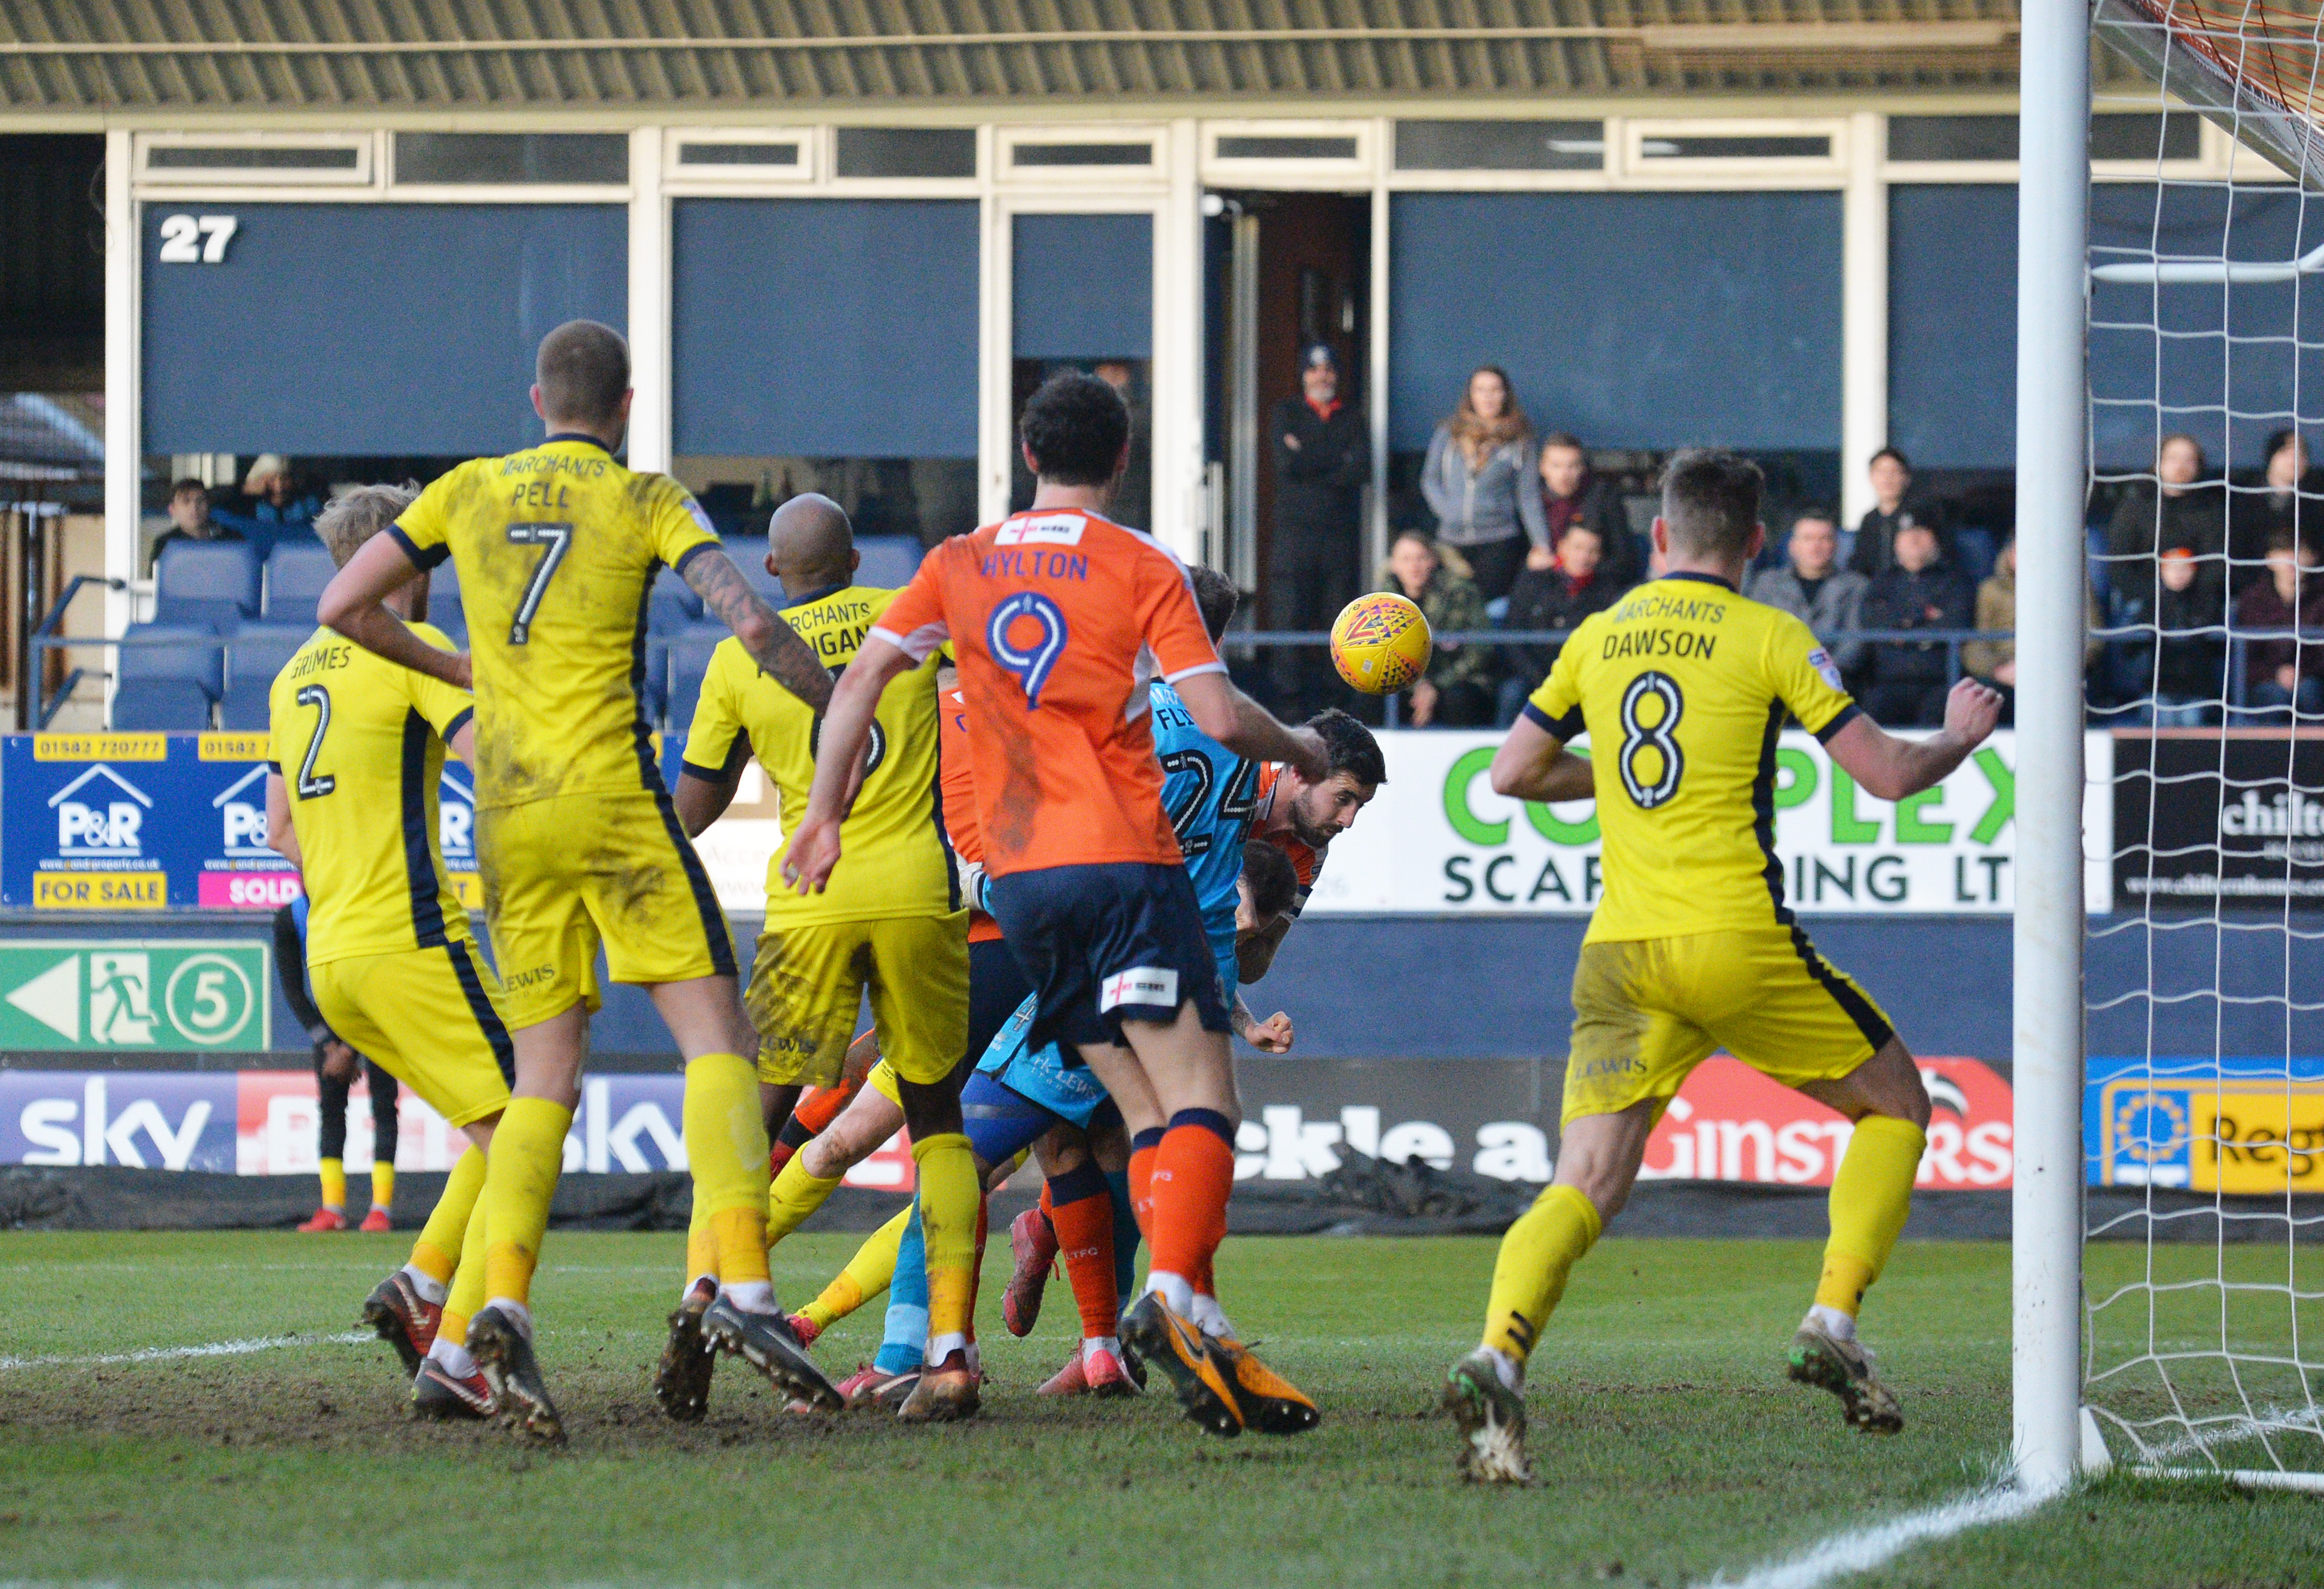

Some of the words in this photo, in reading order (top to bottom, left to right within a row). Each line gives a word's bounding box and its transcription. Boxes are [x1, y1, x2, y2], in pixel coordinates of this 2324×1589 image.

[160, 215, 237, 263] 27
[499, 453, 607, 477] MARCHANTS
[511, 481, 568, 509] PELL
[506, 522, 574, 645] 7
[980, 550, 1088, 582] HYLTON
[790, 602, 871, 632] RCHANTS
[1614, 597, 1726, 624] MARCHANTS
[291, 645, 351, 680] GRIMES
[986, 591, 1067, 711] 9
[1602, 629, 1717, 659] DAWSON
[296, 683, 335, 801] 2
[1619, 670, 1684, 809] 8
[58, 801, 143, 848] P&R
[224, 801, 268, 848] P&
[440, 802, 471, 847] R
[1159, 748, 1261, 855] 24
[41, 881, 90, 901] FOR
[100, 881, 159, 901] SALE
[229, 878, 303, 904] SOLD
[1956, 855, 2012, 902] LT
[190, 971, 229, 1029] 5
[19, 1076, 212, 1172] sky
[1233, 1105, 1456, 1181] ckle
[1472, 1121, 1555, 1181] a
[2214, 1116, 2324, 1176] Reg
